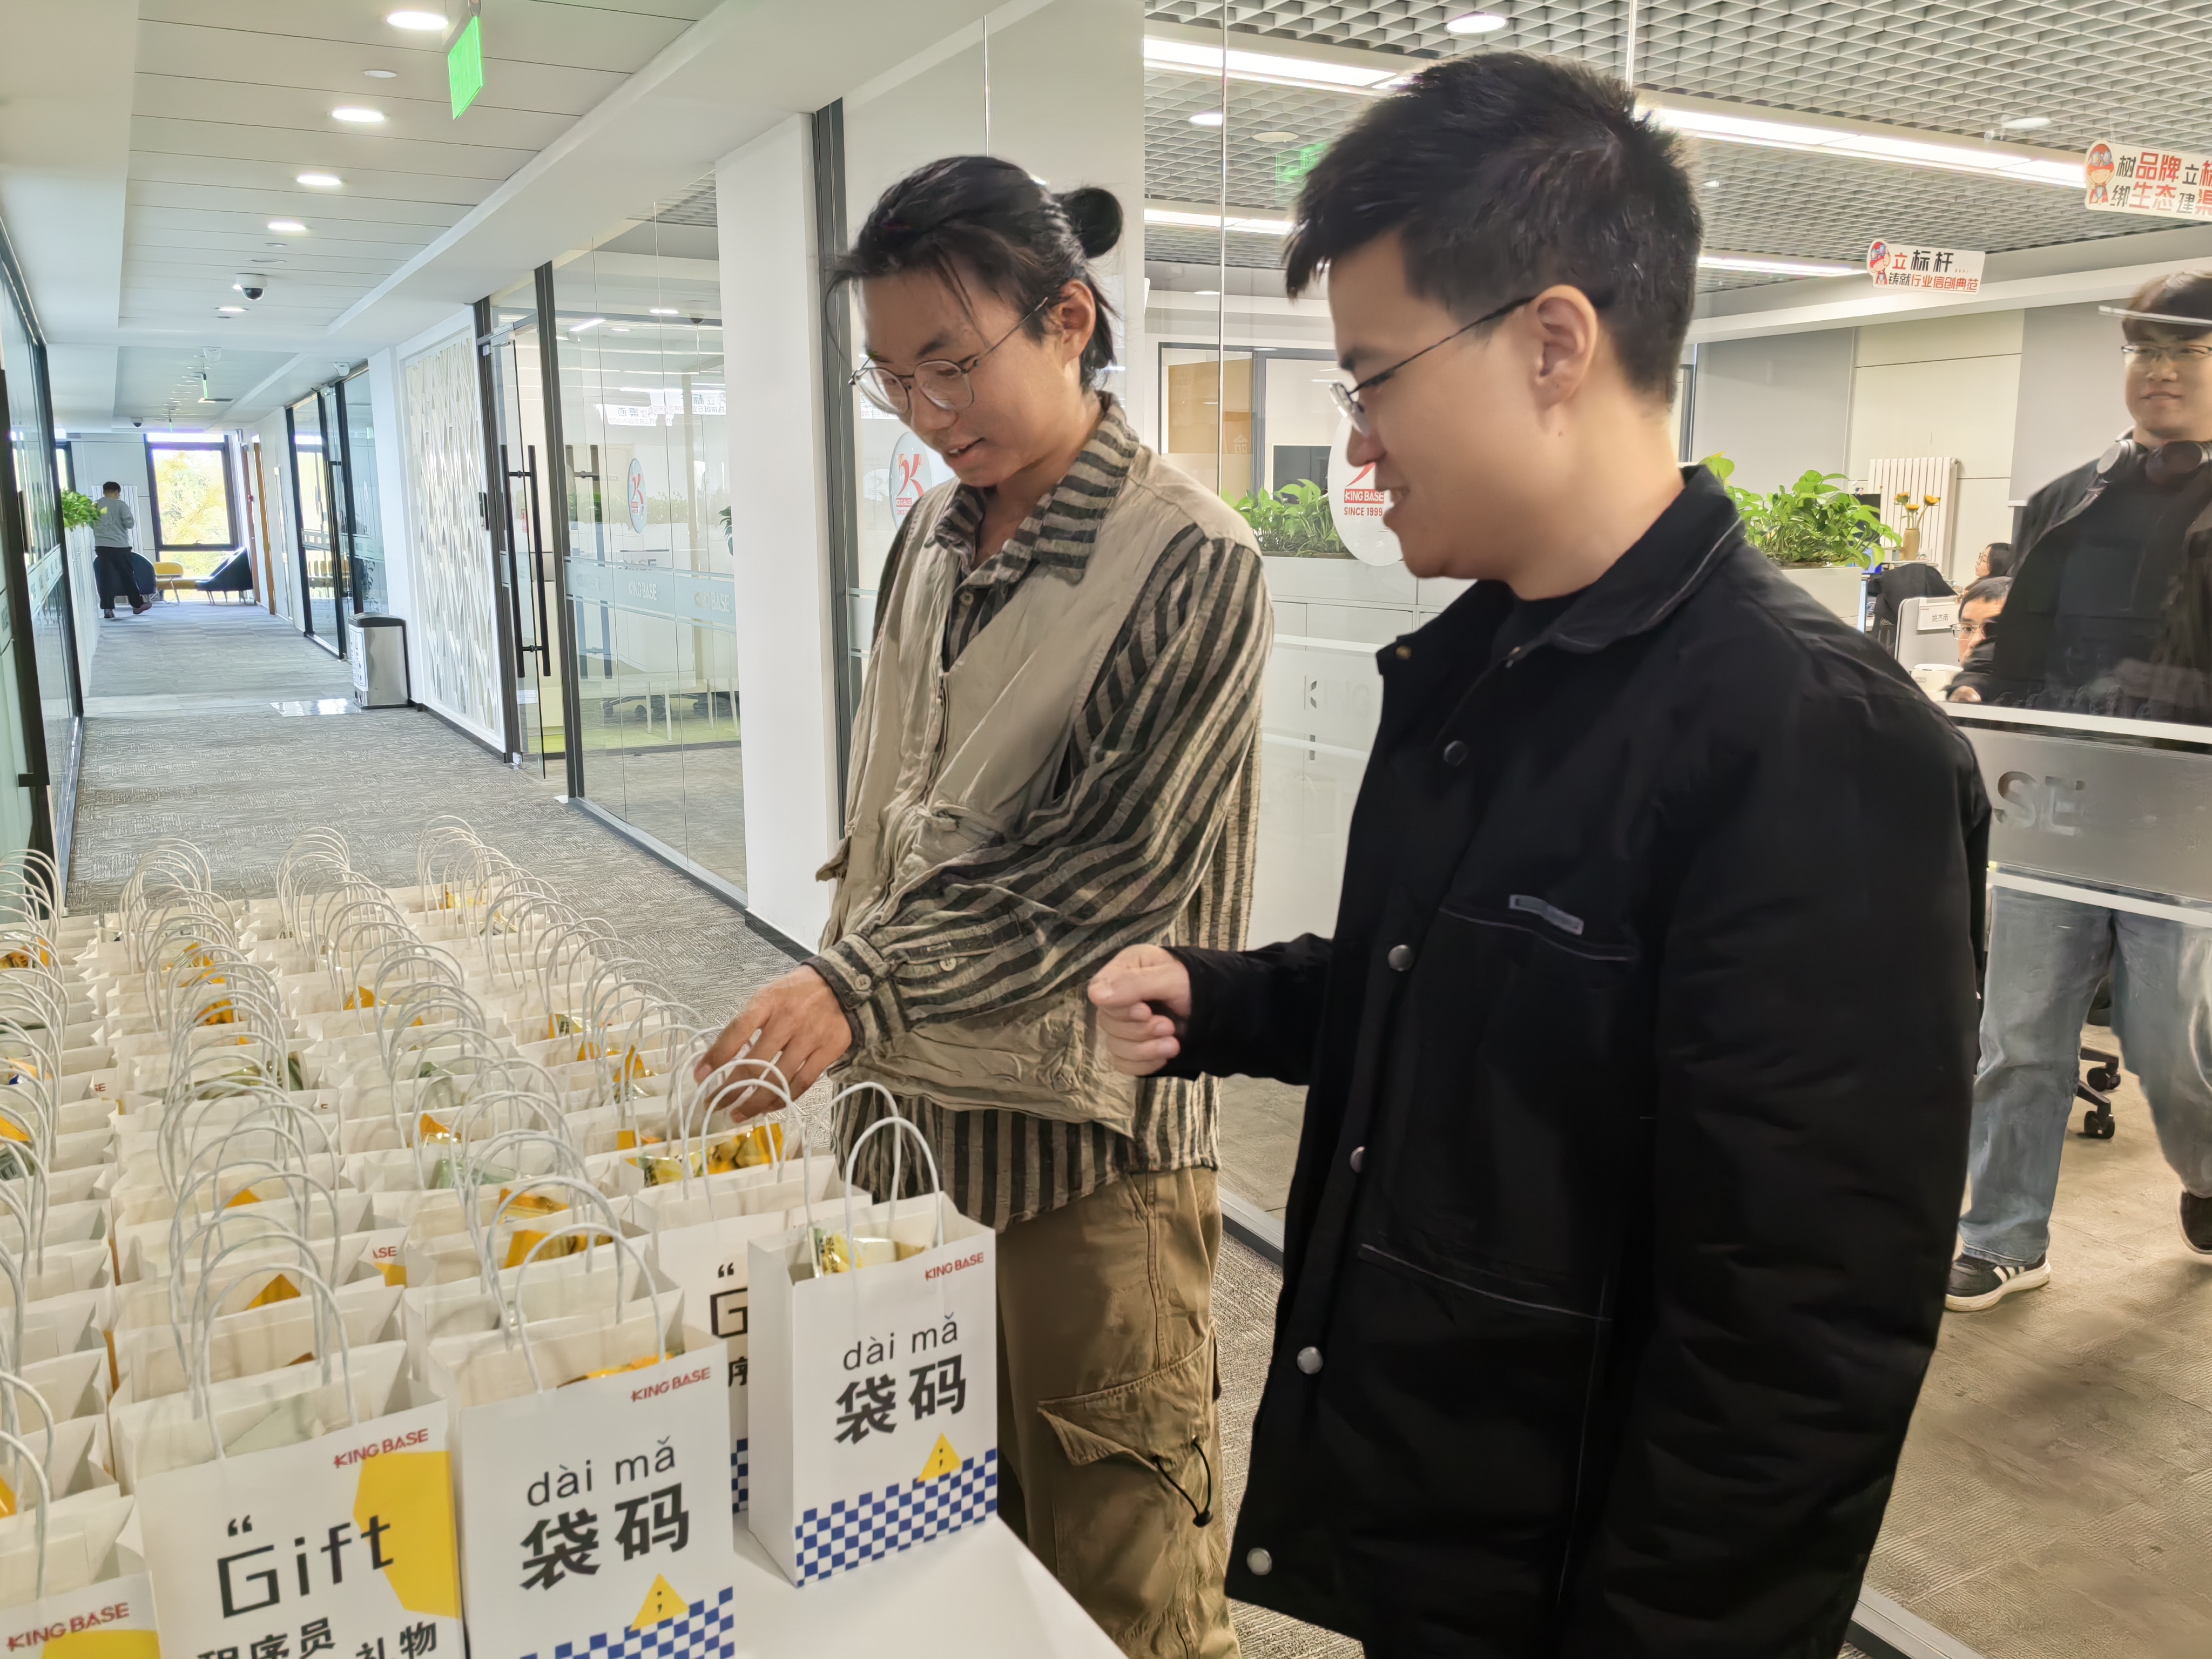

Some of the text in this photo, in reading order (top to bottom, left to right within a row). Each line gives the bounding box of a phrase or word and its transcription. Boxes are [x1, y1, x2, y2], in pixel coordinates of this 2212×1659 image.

[1892, 249, 1954, 273] 立标杆
[1888, 272, 1979, 291] 铸就行业信创典范
[1344, 507, 1382, 516] SINCE 1999
[842, 1332, 895, 1371] dài
[834, 1354, 966, 1445] 袋码
[527, 1459, 592, 1507] dài
[519, 1481, 690, 1591] 袋码
